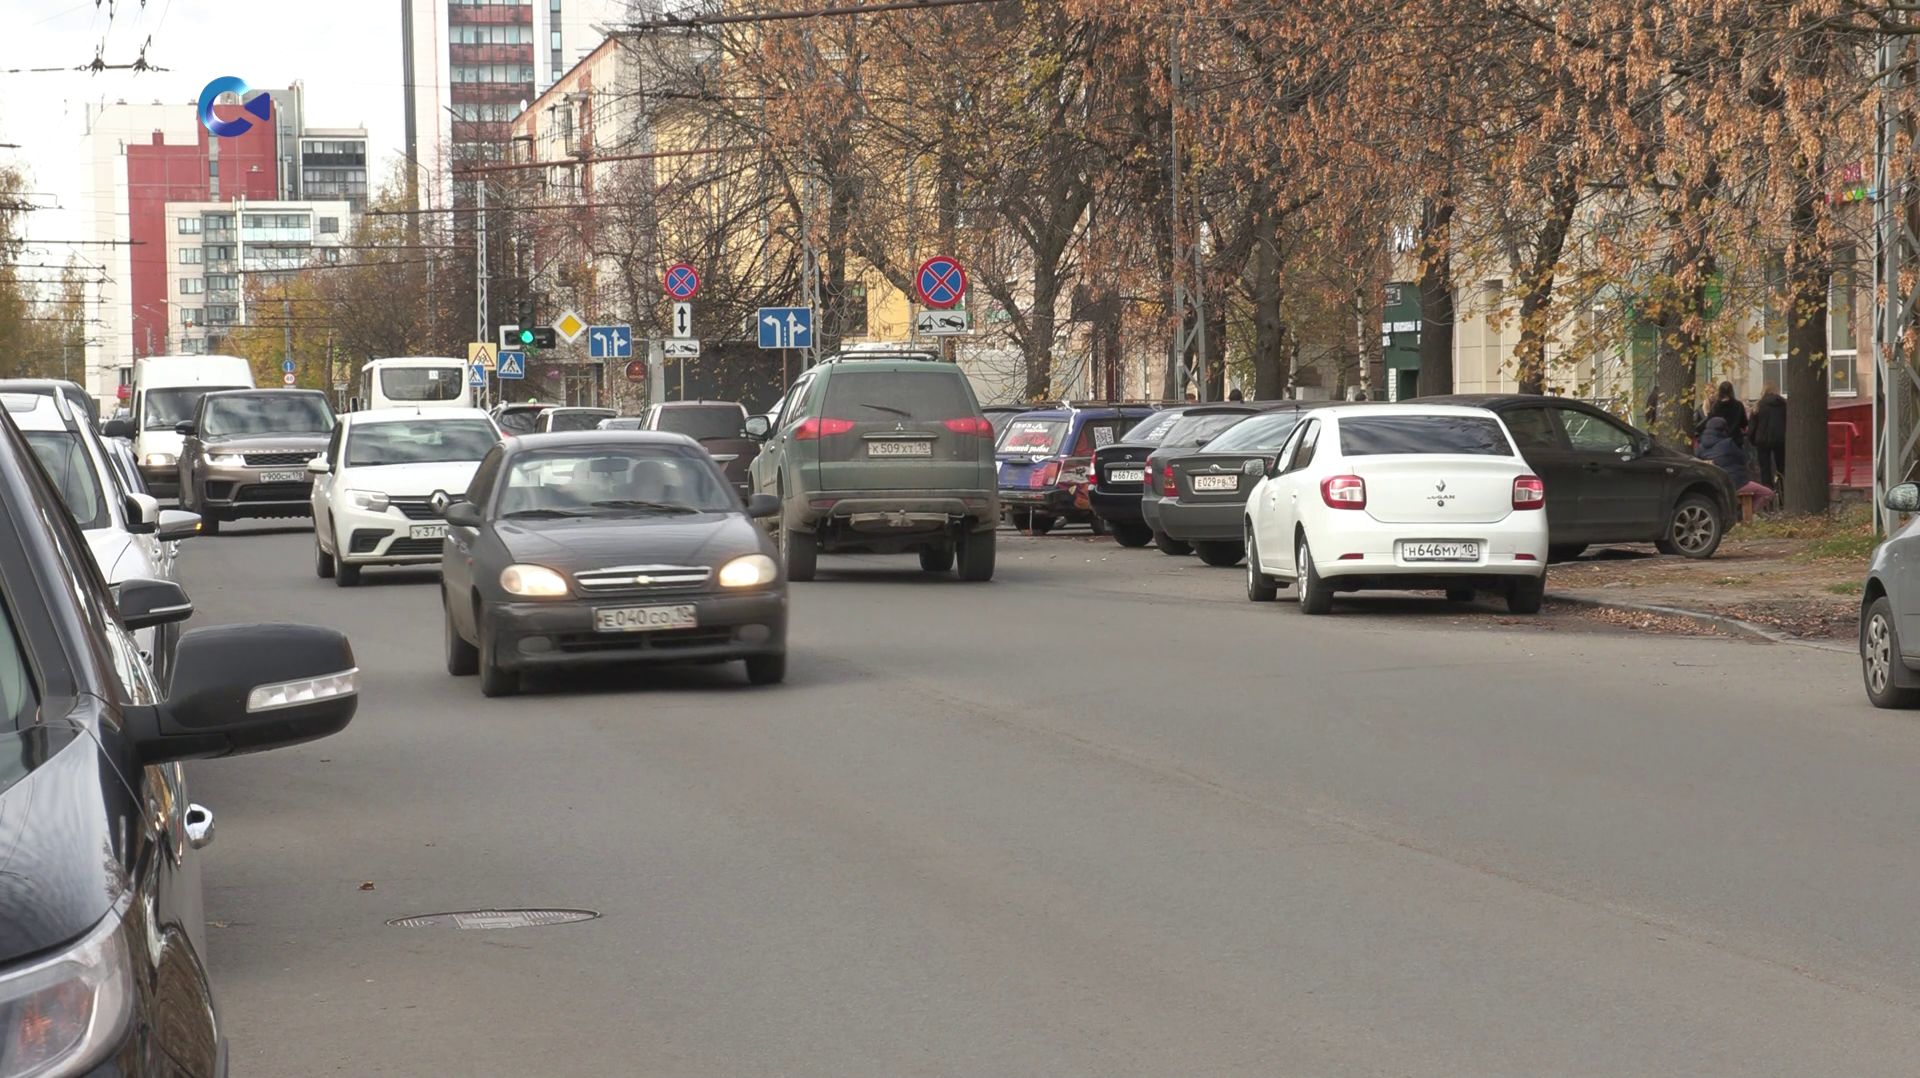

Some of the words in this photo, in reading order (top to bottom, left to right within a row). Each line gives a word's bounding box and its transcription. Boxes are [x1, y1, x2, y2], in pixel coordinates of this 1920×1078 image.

[872, 443, 913, 454] К509ХТ
[1408, 544, 1458, 556] Н646МУ
[1462, 543, 1475, 554] 10
[604, 608, 670, 627] Е040СО
